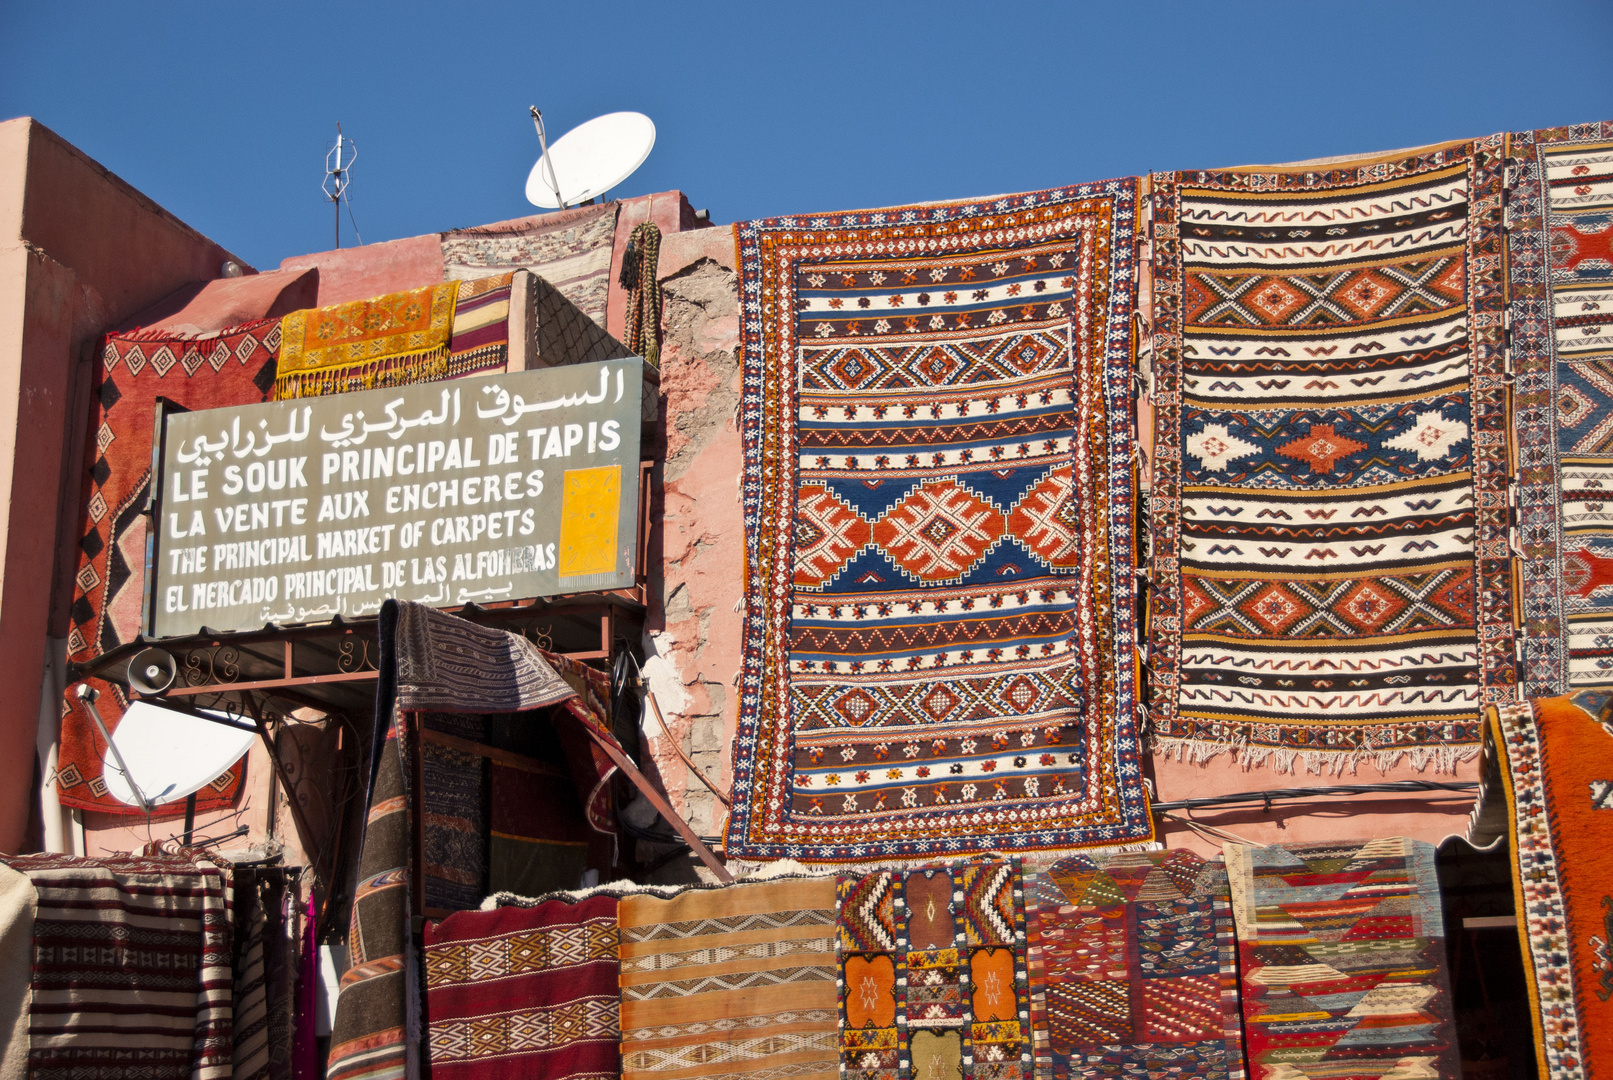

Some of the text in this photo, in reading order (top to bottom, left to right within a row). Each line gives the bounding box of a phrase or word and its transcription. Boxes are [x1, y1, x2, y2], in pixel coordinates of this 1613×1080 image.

[177, 366, 624, 467] السوق المركزي للزرابي
[173, 419, 621, 502] LE SOUK PRINCIPAL DE TAPIS
[170, 469, 545, 538] LA VENTE AUX ENCHERES
[169, 508, 536, 575] THE PRINCIPAL MARKET OF CARPETS
[165, 542, 556, 613] EL MERCADO PRINCIPAL DE LAS ALFOMBRAS
